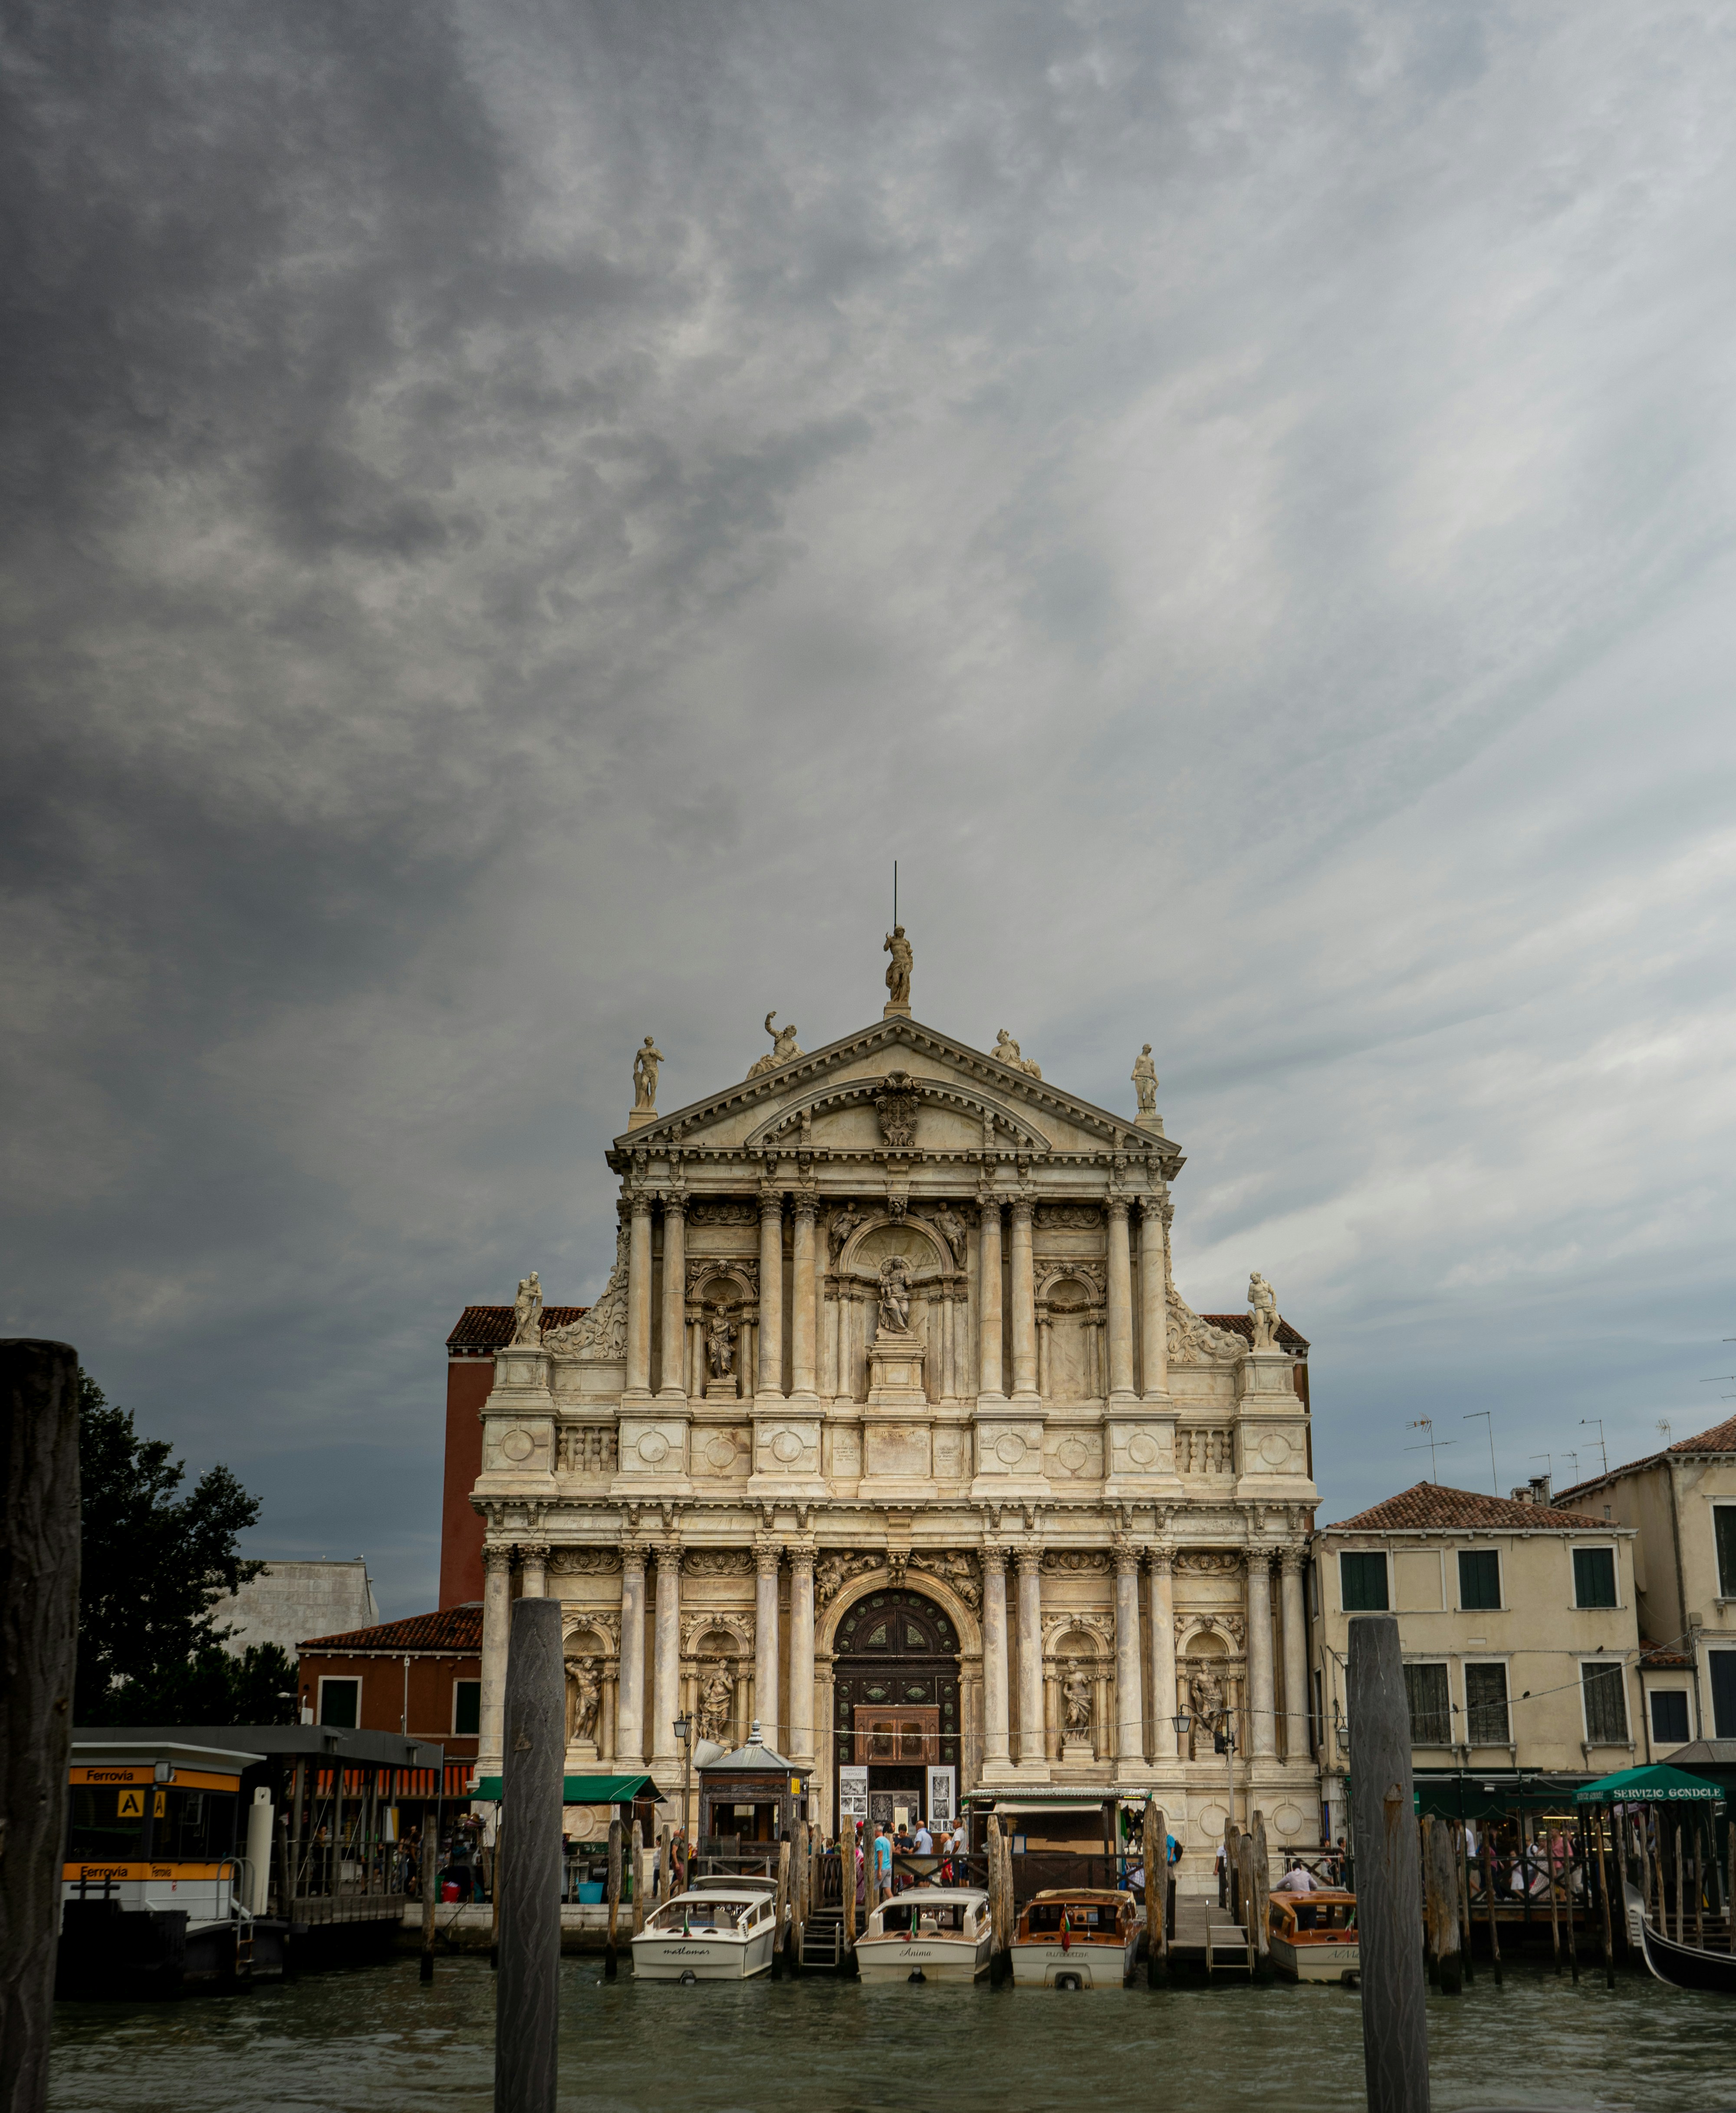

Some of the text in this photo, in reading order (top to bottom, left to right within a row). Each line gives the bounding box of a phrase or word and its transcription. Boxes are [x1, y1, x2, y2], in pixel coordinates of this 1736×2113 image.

[87, 1770, 134, 1781] Ferrovia
[1614, 1788, 1721, 1798] SERVIZIO GONDOLE
[121, 1794, 140, 1813] A
[155, 1794, 163, 1814] A
[81, 1866, 128, 1877] Ferrovia
[152, 1866, 171, 1877] Ferrovia
[899, 1947, 933, 1957] Anima
